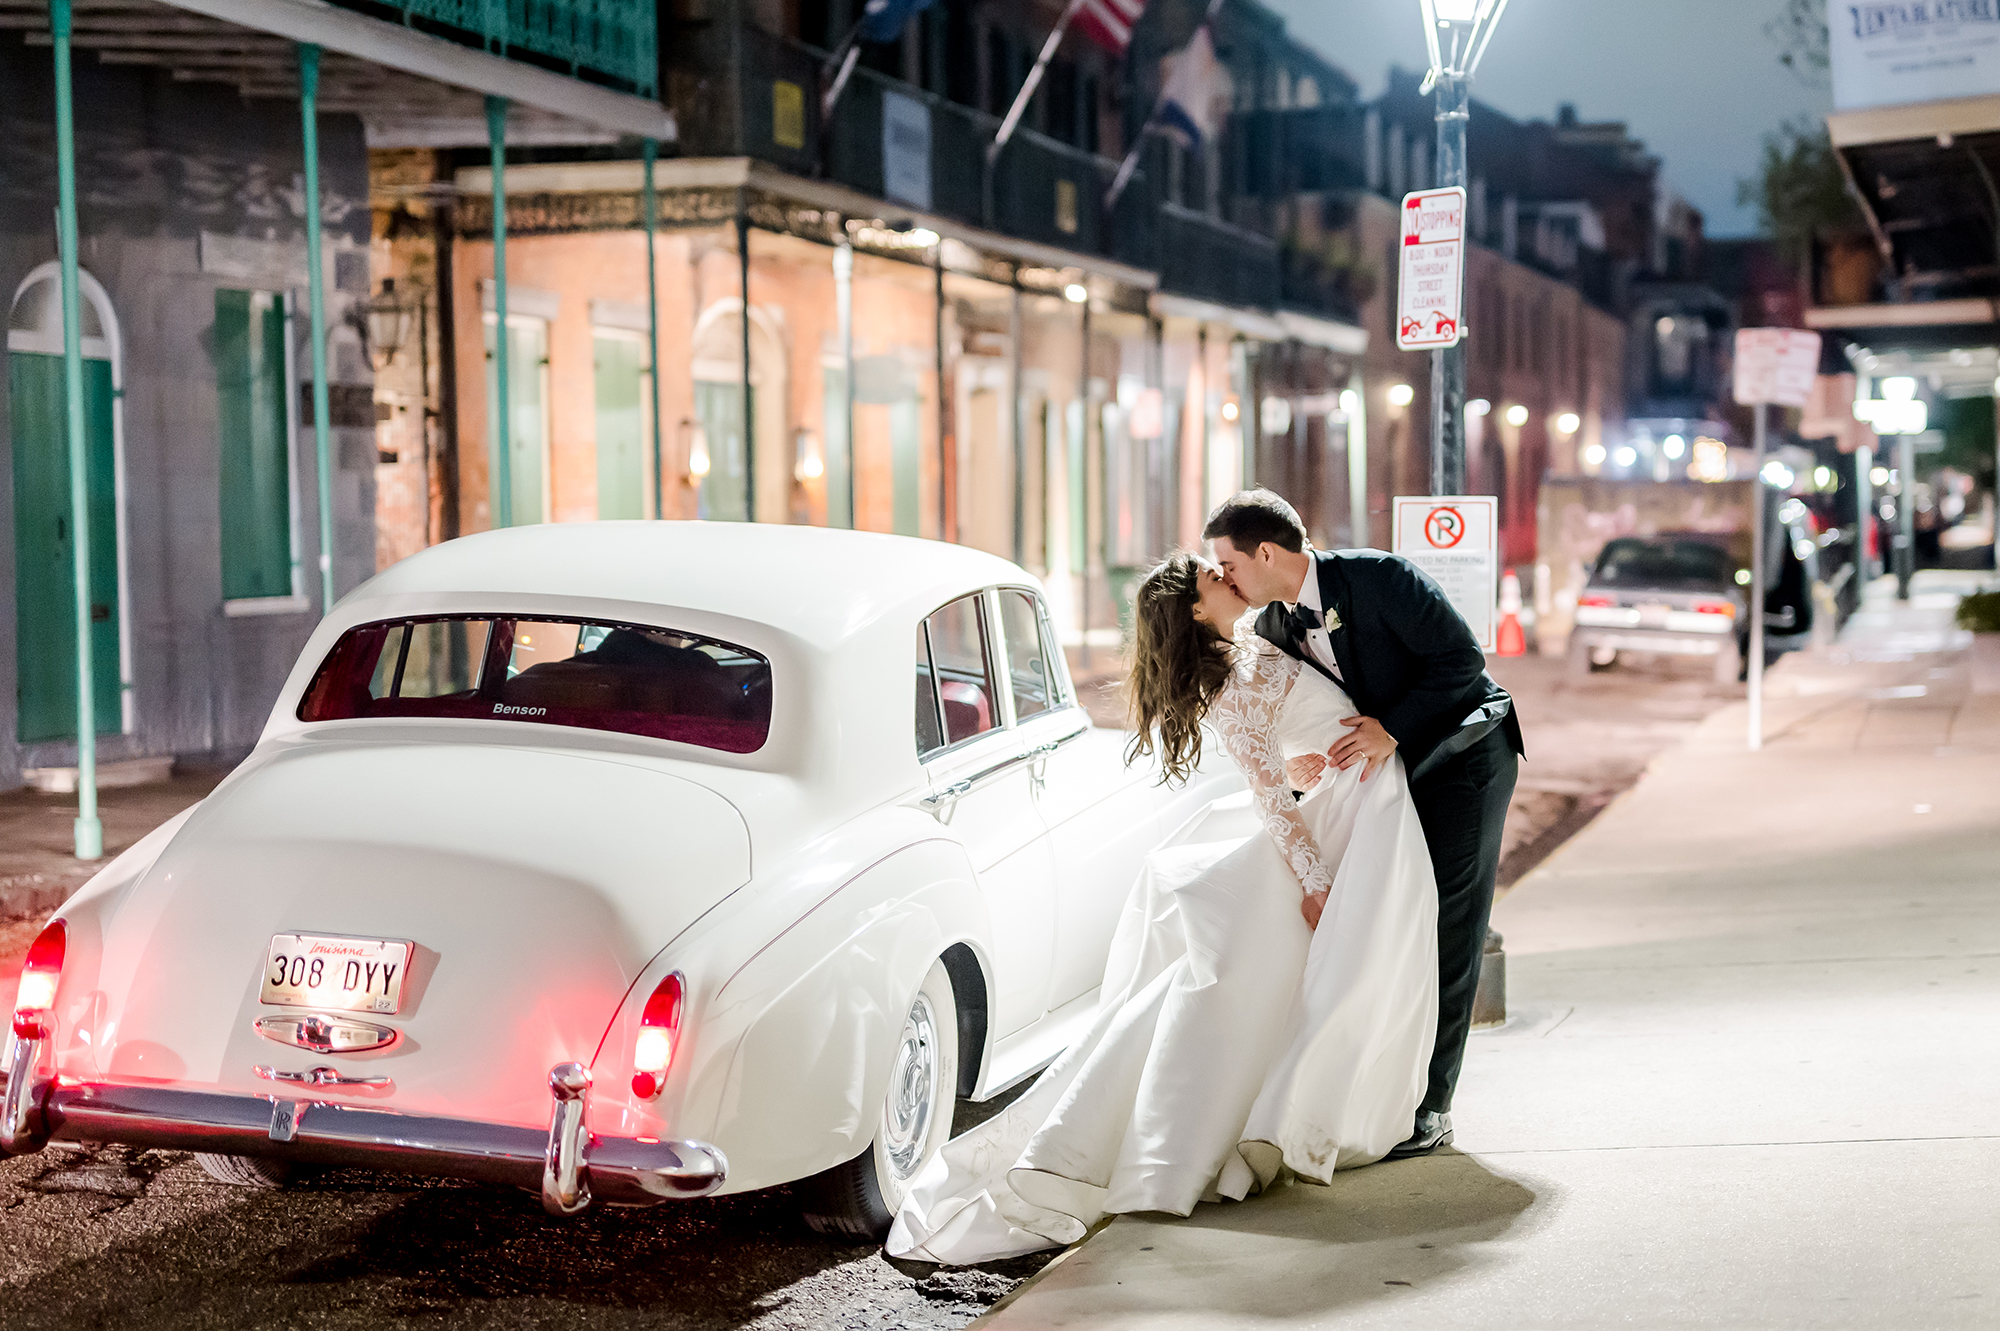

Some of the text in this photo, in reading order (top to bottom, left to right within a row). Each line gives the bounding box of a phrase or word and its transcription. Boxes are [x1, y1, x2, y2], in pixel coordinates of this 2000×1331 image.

[1405, 207, 1460, 235] NO STOPPING
[1434, 246, 1454, 257] NOON
[1413, 263, 1449, 276] THURSDAY
[1418, 279, 1443, 292] STREET
[1412, 295, 1447, 309] CLEANING
[1435, 556, 1448, 565] NO
[1450, 556, 1485, 565] PARKING
[493, 703, 547, 716] Benson
[309, 942, 374, 957] Louisiana
[271, 956, 396, 995] 308 DYY
[378, 1001, 391, 1009] 22
